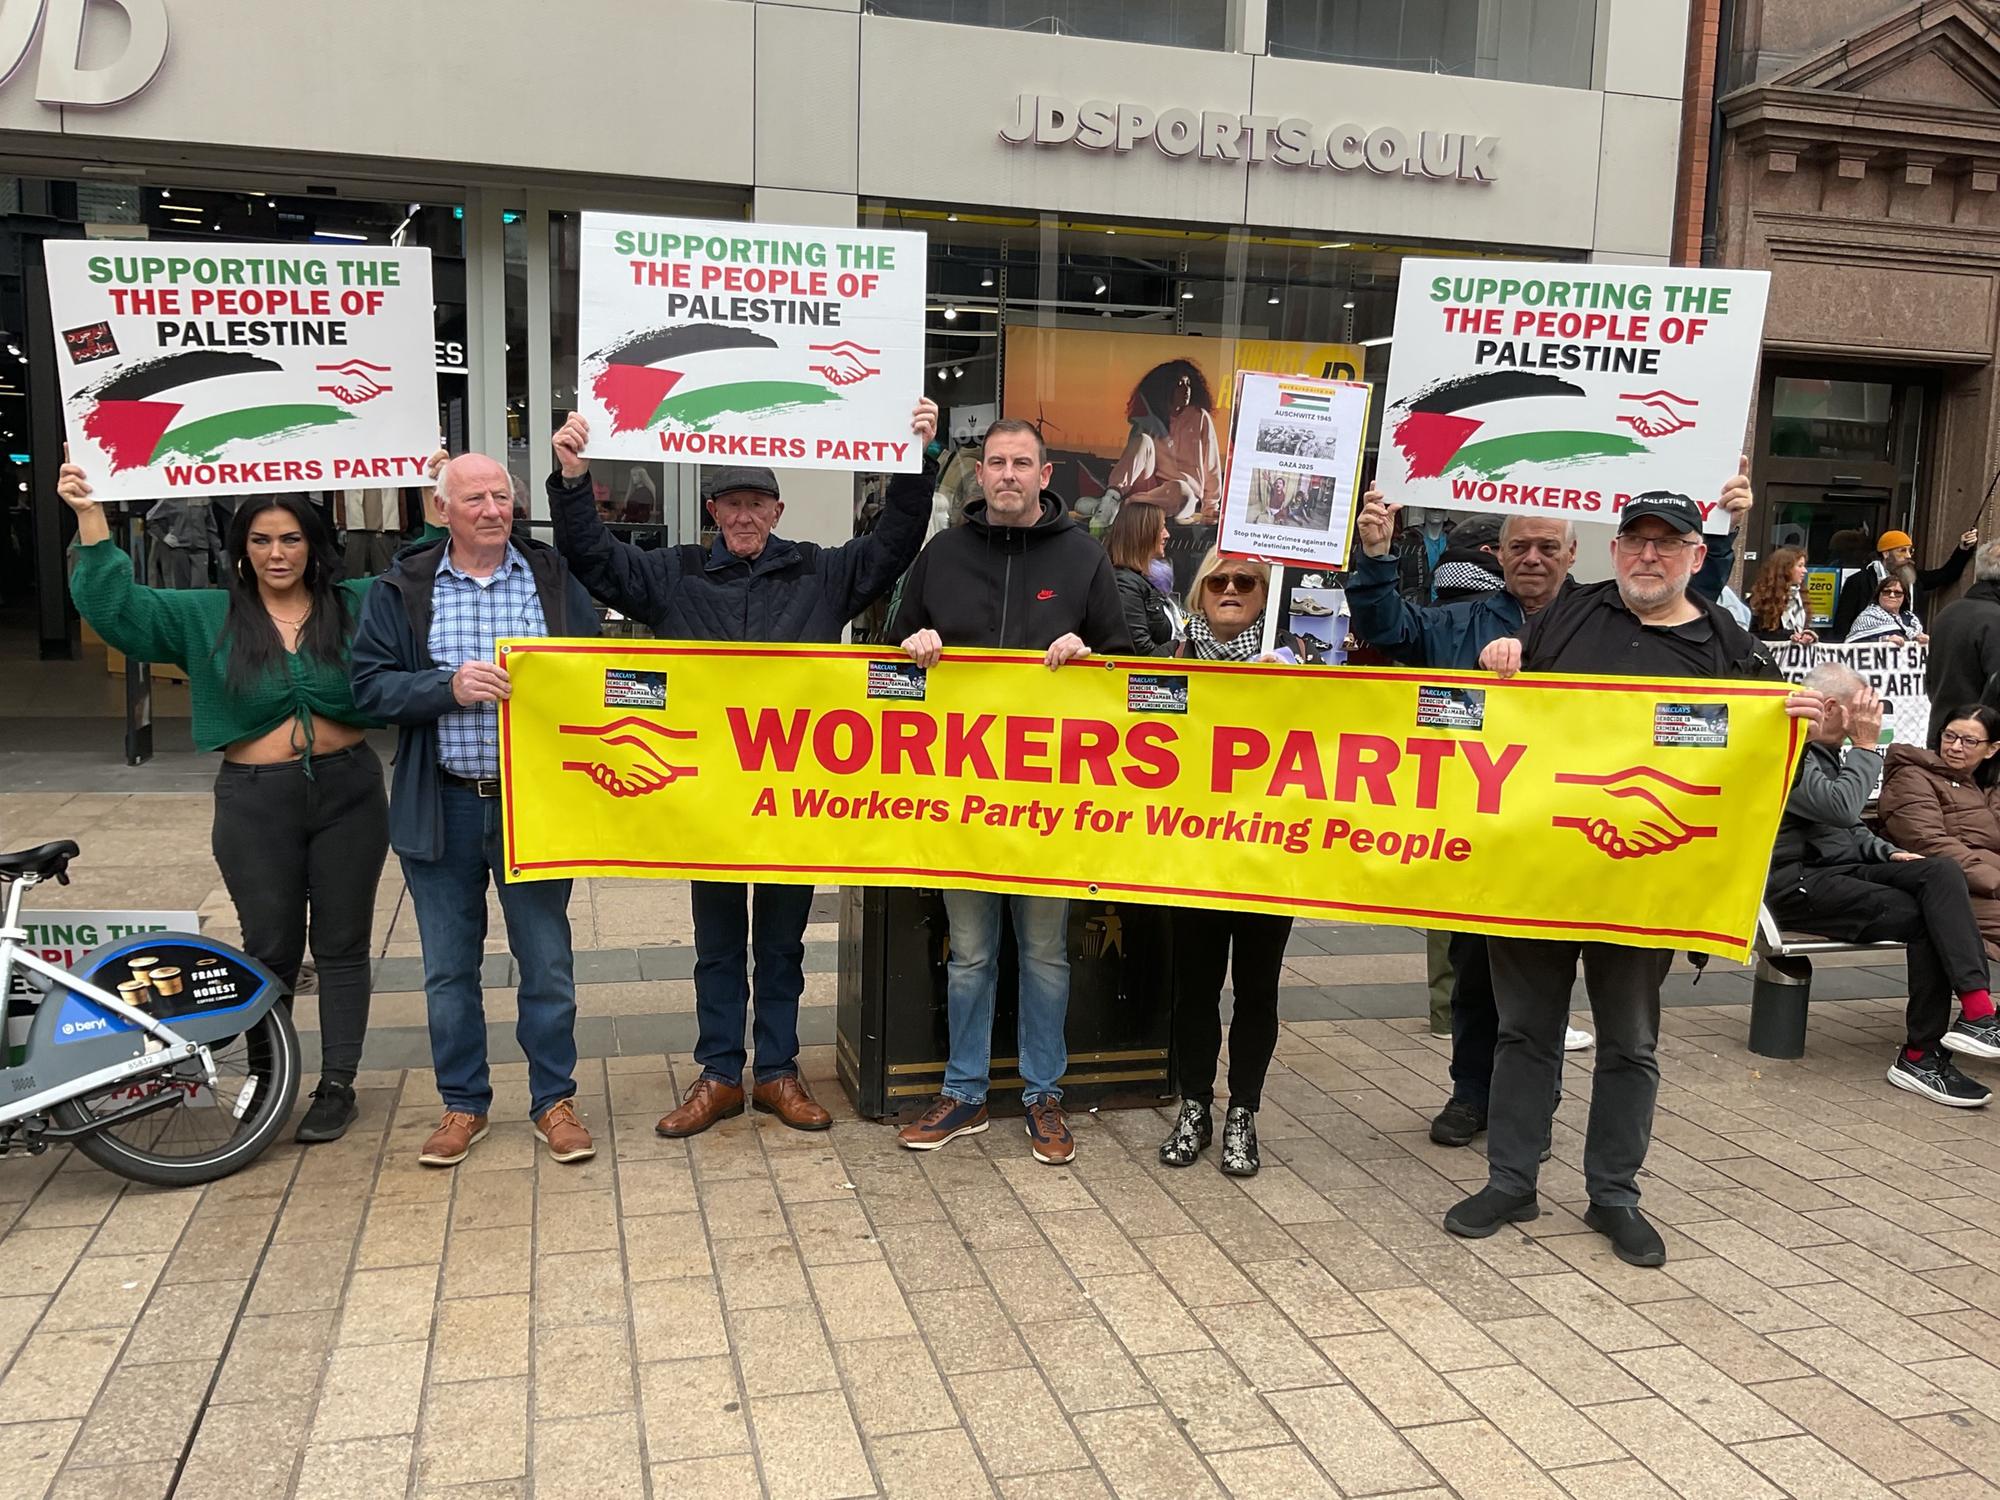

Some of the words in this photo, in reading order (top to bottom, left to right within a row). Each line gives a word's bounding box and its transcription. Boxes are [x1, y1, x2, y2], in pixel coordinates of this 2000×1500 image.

[999, 94, 1501, 183] JDSPORTS.CO.UK
[614, 231, 826, 267] SUPPORTING
[836, 244, 895, 270] THE
[88, 257, 325, 285] SUPPORTING
[336, 261, 400, 286] THE
[630, 260, 690, 288] THE
[701, 265, 827, 297] PEOPLE
[837, 274, 879, 298] OF
[108, 289, 181, 316] THE
[191, 289, 331, 316] PEOPLE
[340, 290, 385, 316] OF
[667, 293, 841, 327] PALESTINE
[1430, 276, 1651, 311] SUPPORTING
[1663, 285, 1731, 314] THE
[156, 321, 348, 347] PALESTINE
[1443, 307, 1505, 335] THE
[1513, 310, 1650, 343] PEOPLE
[1659, 317, 1709, 345] OF
[1475, 340, 1661, 375] PALESTINE
[1274, 410, 1316, 420] AUSCHWITZ
[659, 432, 807, 459] WORKERS
[816, 440, 909, 462] PARTY
[164, 459, 324, 486] WORKERS
[333, 456, 428, 479] PARTY
[1278, 460, 1298, 469] GAZA
[1452, 479, 1602, 512] WORKERS
[1233, 529, 1249, 538] Stop
[1277, 535, 1301, 543] Crimes
[1301, 538, 1326, 547] against
[1253, 541, 1290, 550] Palestinian
[726, 707, 1181, 789] WORKERS
[1210, 725, 1527, 815] PARTY
[752, 787, 778, 817] A
[792, 787, 950, 823] Workers
[959, 795, 1065, 837] Party
[1074, 800, 1134, 834] for
[1146, 804, 1313, 854] Working
[1322, 818, 1473, 865] People
[191, 968, 228, 981] FRANK
[193, 983, 235, 998] HONEST
[75, 1017, 107, 1032] beryl
